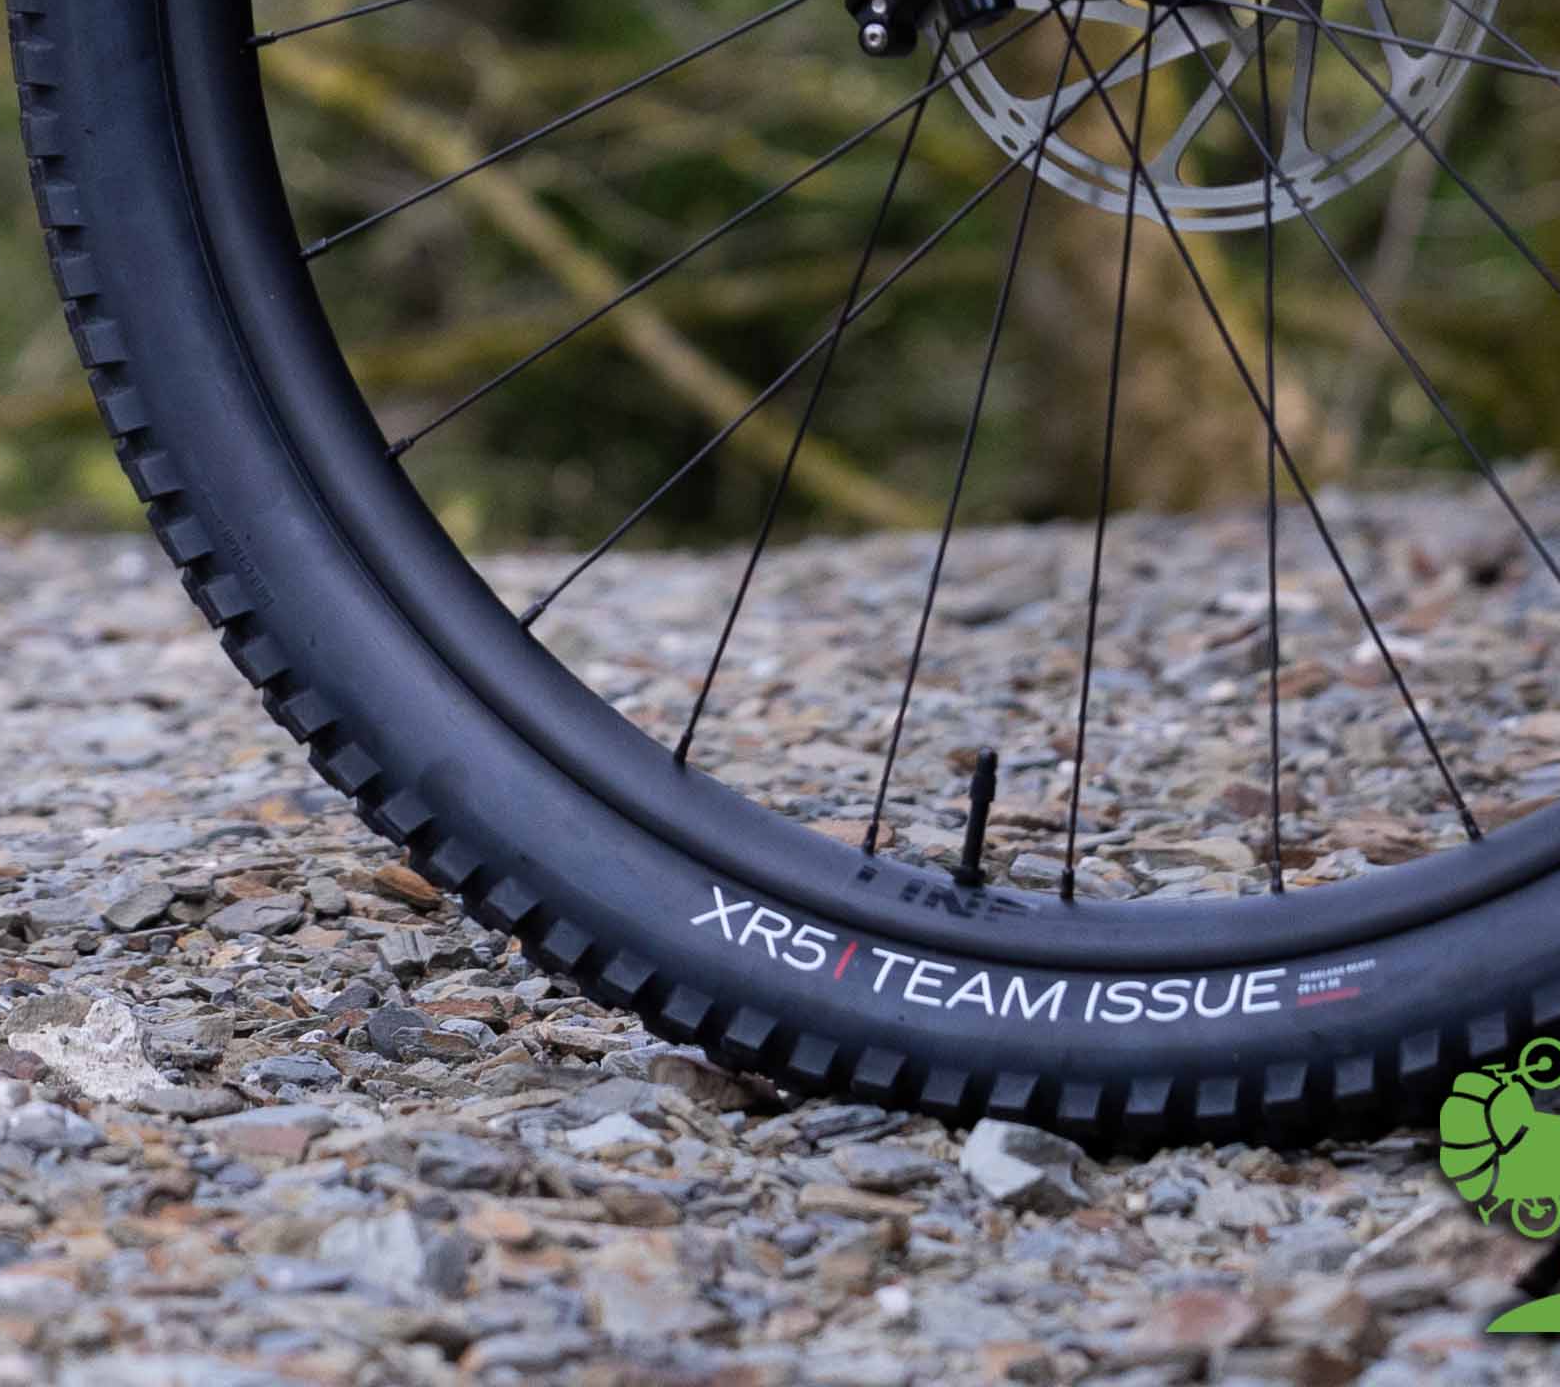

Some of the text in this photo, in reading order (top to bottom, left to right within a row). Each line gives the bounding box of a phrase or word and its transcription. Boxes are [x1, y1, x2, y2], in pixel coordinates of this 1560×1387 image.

[690, 885, 1287, 1024] XR5 TEAM ISSUE
